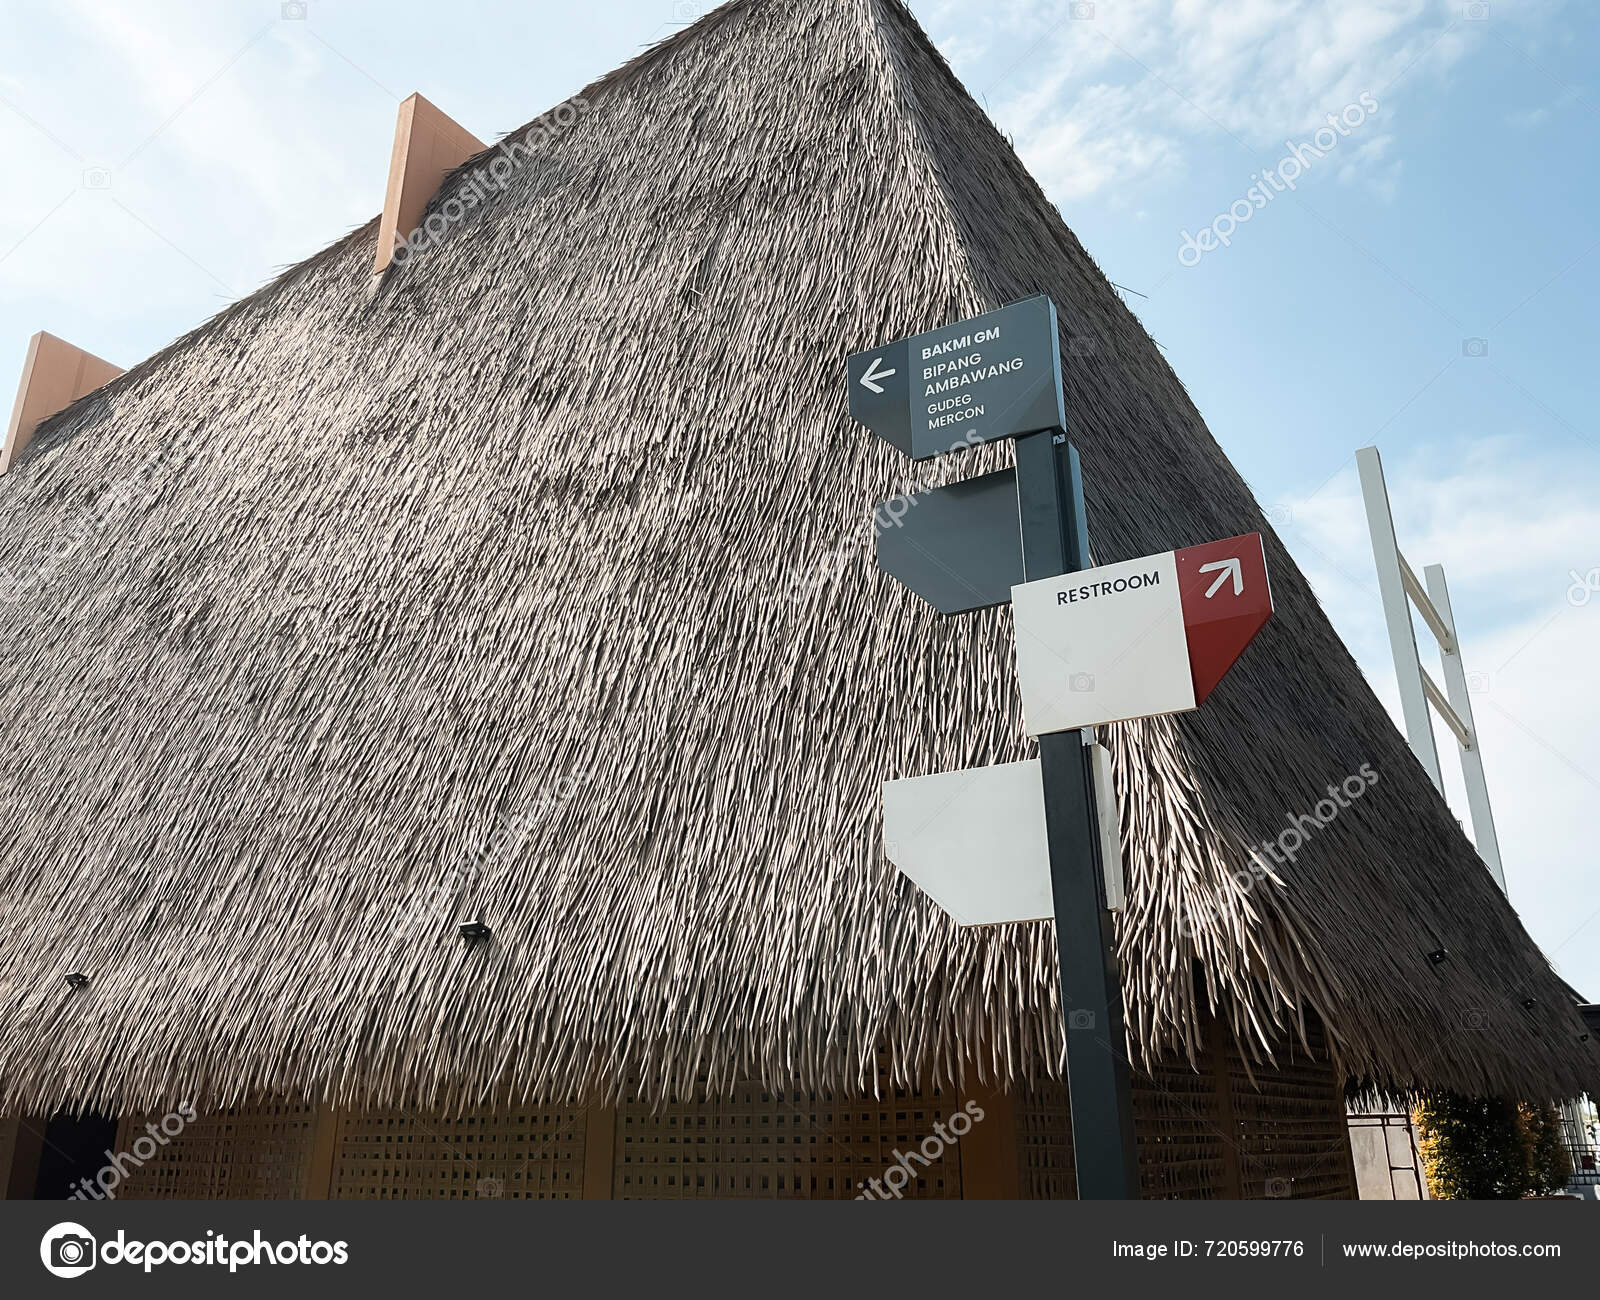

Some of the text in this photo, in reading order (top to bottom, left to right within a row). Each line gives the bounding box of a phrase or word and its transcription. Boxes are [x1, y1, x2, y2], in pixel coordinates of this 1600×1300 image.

[922, 326, 1000, 360] BAKMI GM
[923, 353, 982, 380] BIPANG
[924, 357, 1024, 397] AMBAWANG
[927, 394, 972, 415] GUDEG
[928, 405, 985, 430] MERCON
[1057, 571, 1160, 605] RESTROOM
